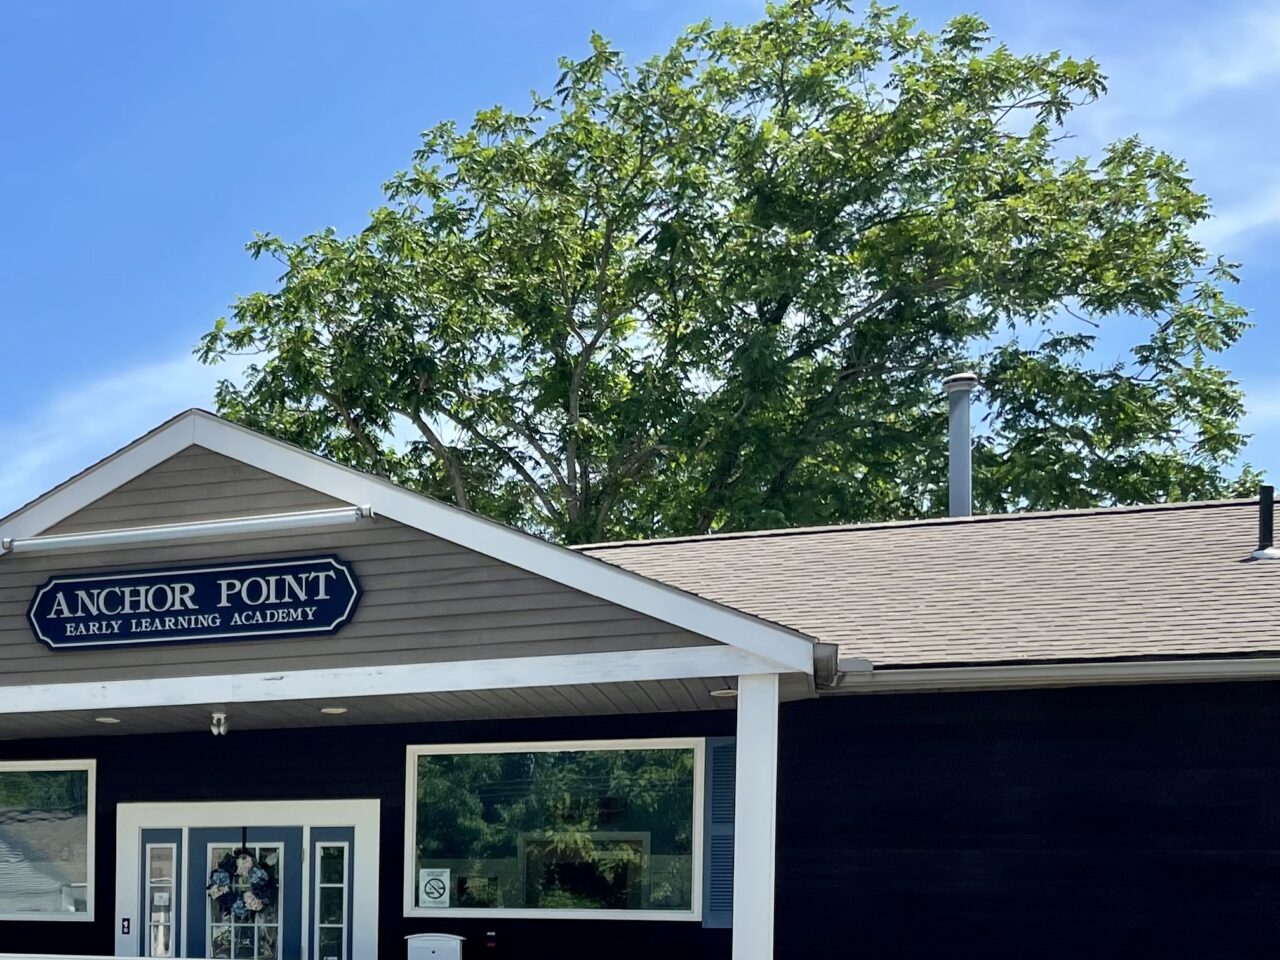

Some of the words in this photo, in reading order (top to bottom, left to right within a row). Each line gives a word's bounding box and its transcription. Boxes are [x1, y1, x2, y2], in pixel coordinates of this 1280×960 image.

[46, 582, 199, 619] ANCHOR
[216, 569, 337, 608] POINT
[65, 620, 123, 636] EARLY
[130, 613, 222, 633] LEARNING
[230, 606, 318, 626] ACADEMY
